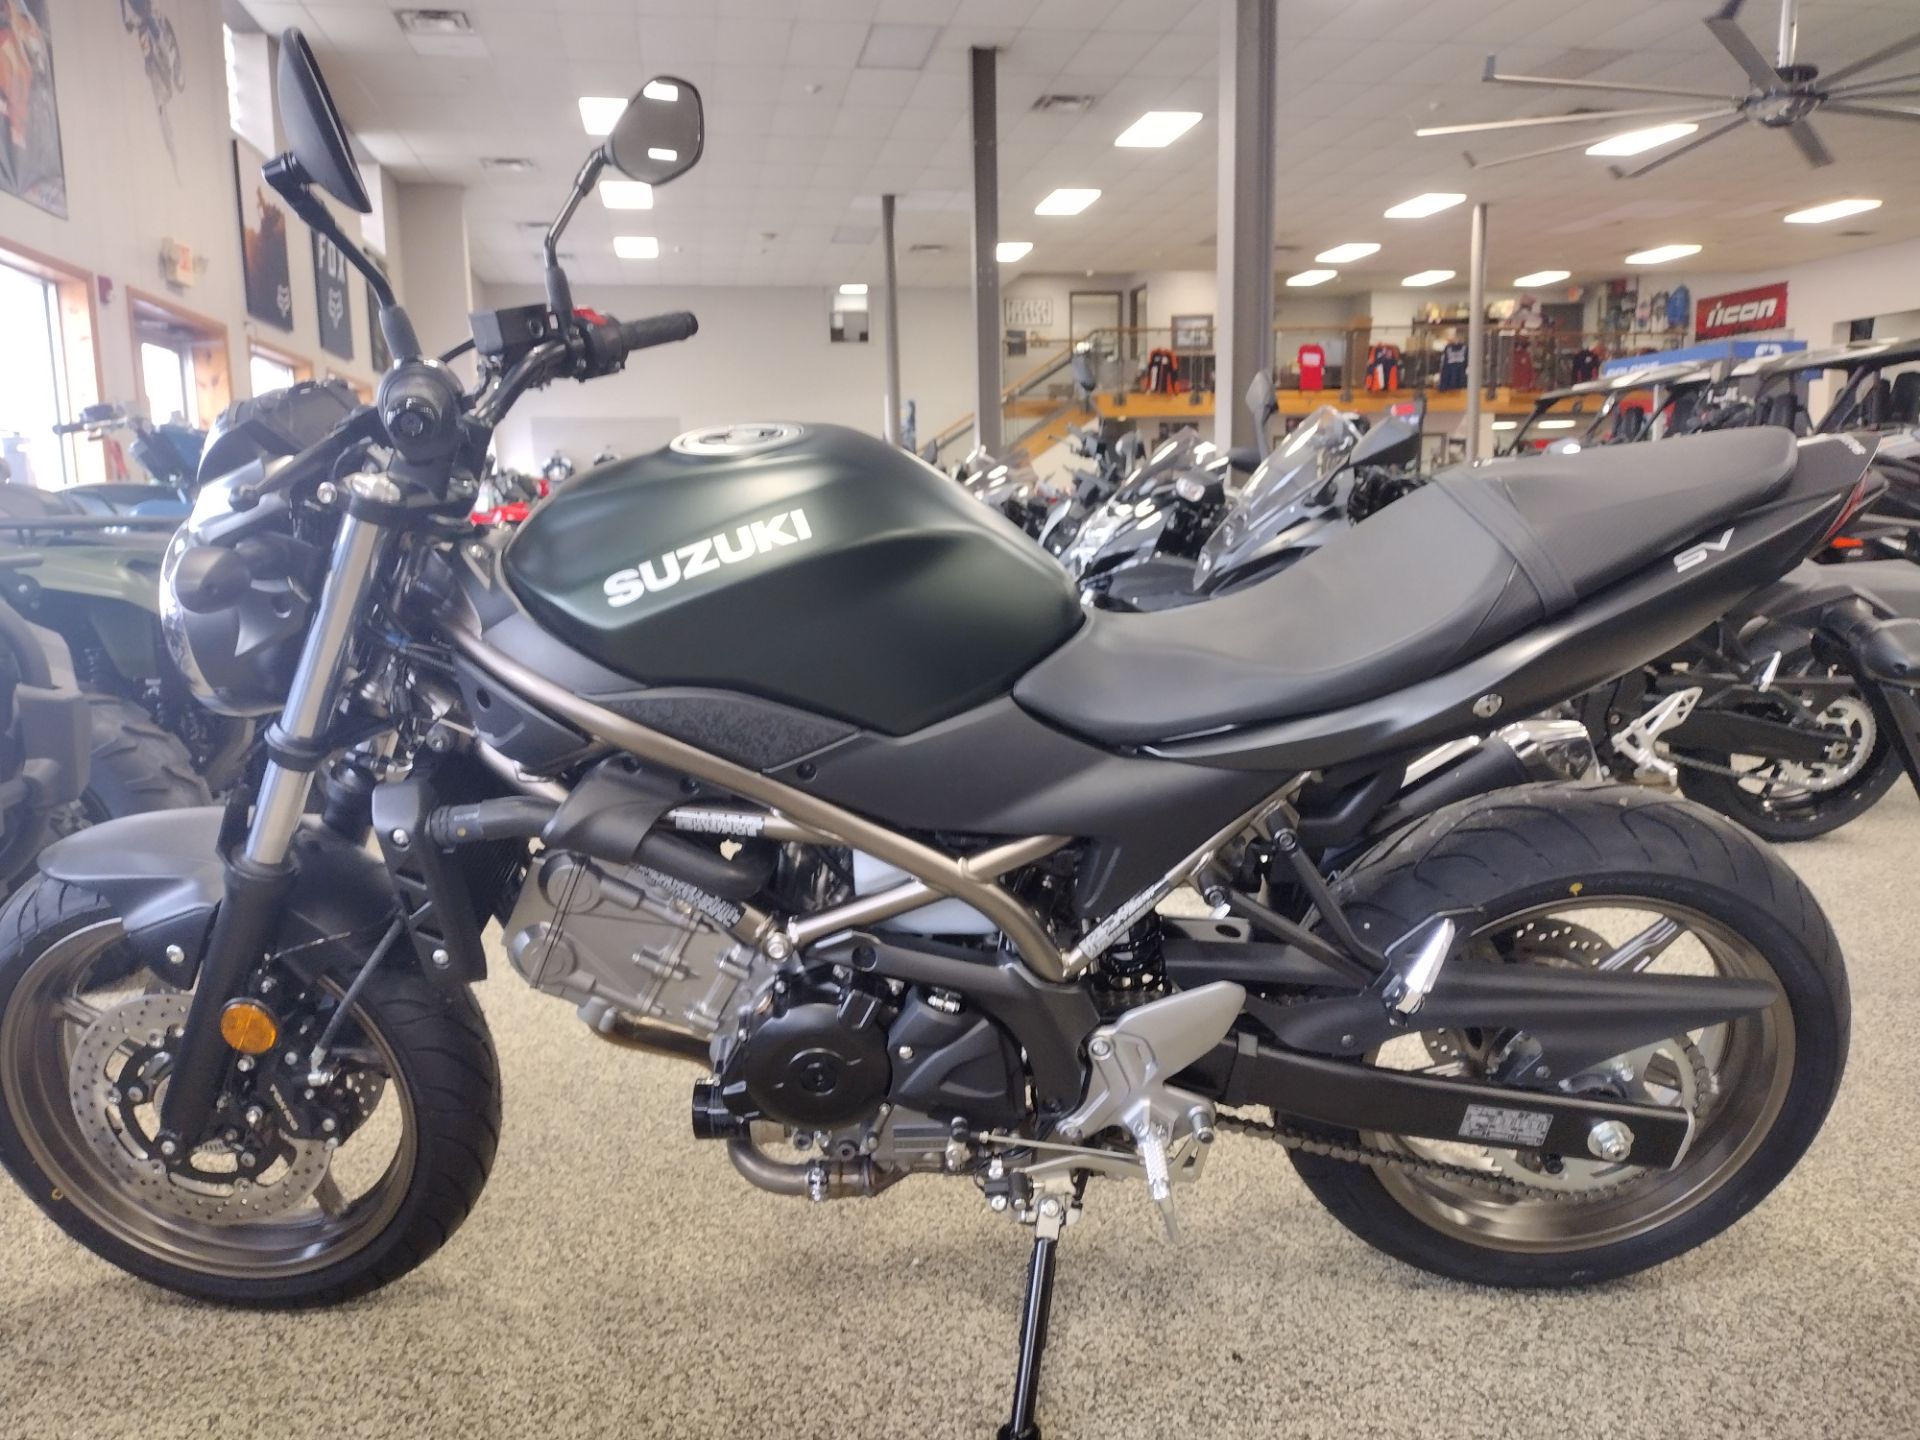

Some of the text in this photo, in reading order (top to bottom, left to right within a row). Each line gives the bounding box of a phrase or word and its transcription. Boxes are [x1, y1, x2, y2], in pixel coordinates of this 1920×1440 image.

[318, 232, 346, 284] FOX
[603, 508, 813, 607] SUZUKI
[1673, 527, 1735, 573] SV
